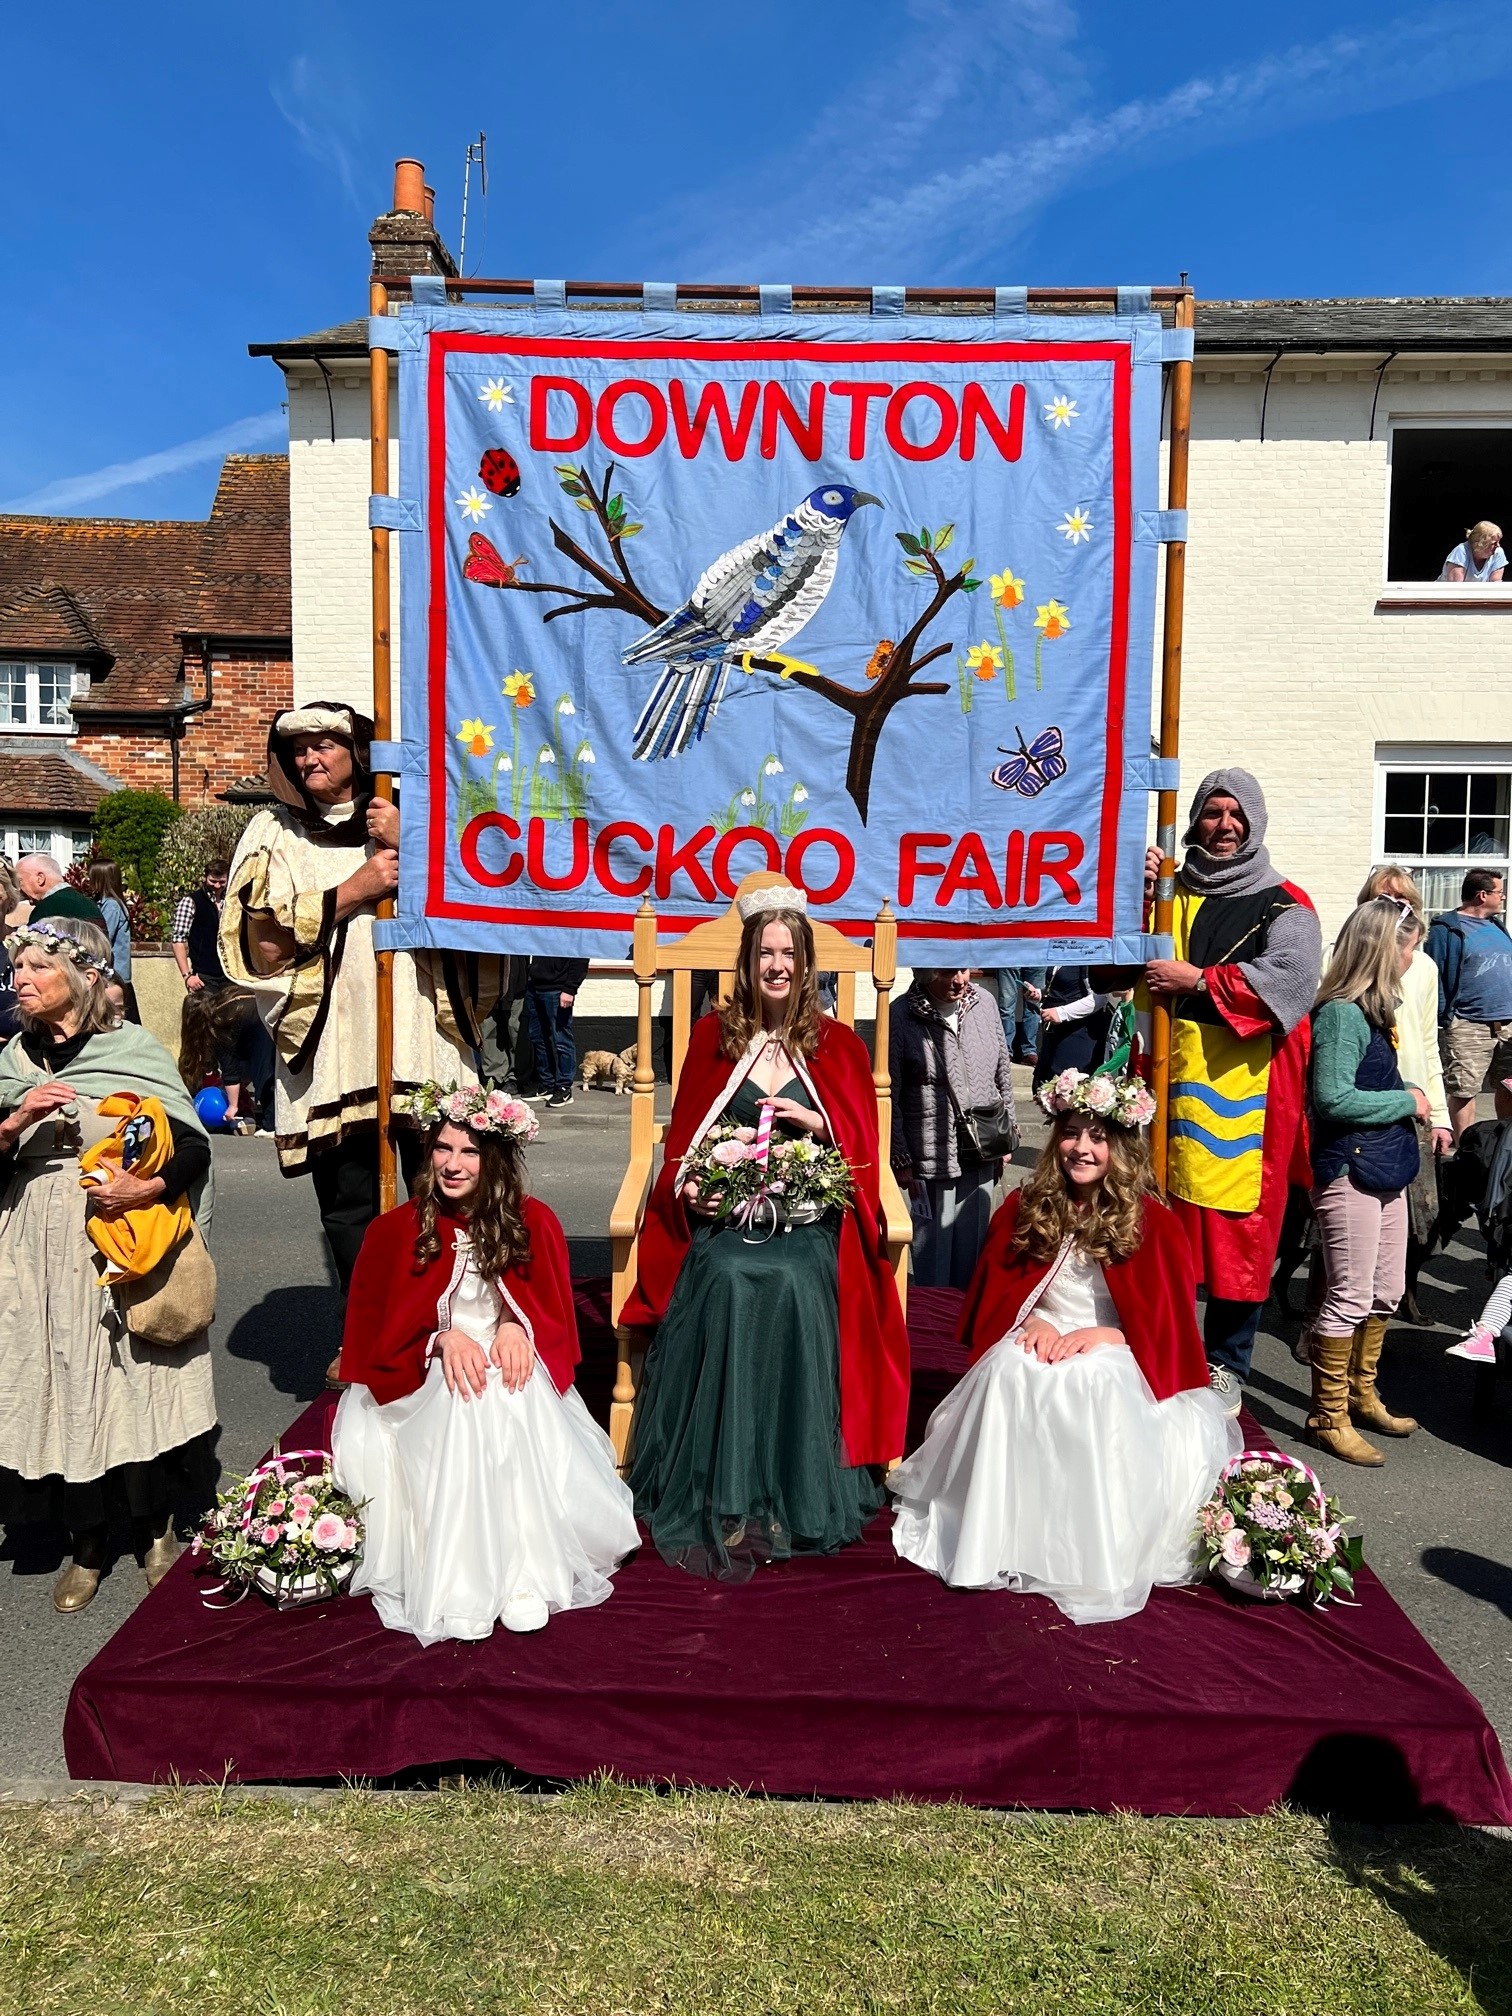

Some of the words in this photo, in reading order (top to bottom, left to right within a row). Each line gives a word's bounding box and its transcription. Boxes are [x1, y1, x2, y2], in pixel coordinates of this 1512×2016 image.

[529, 375, 1026, 462] DOWNTON
[459, 811, 856, 905] CUCKOO
[897, 829, 1085, 909] FAIR
